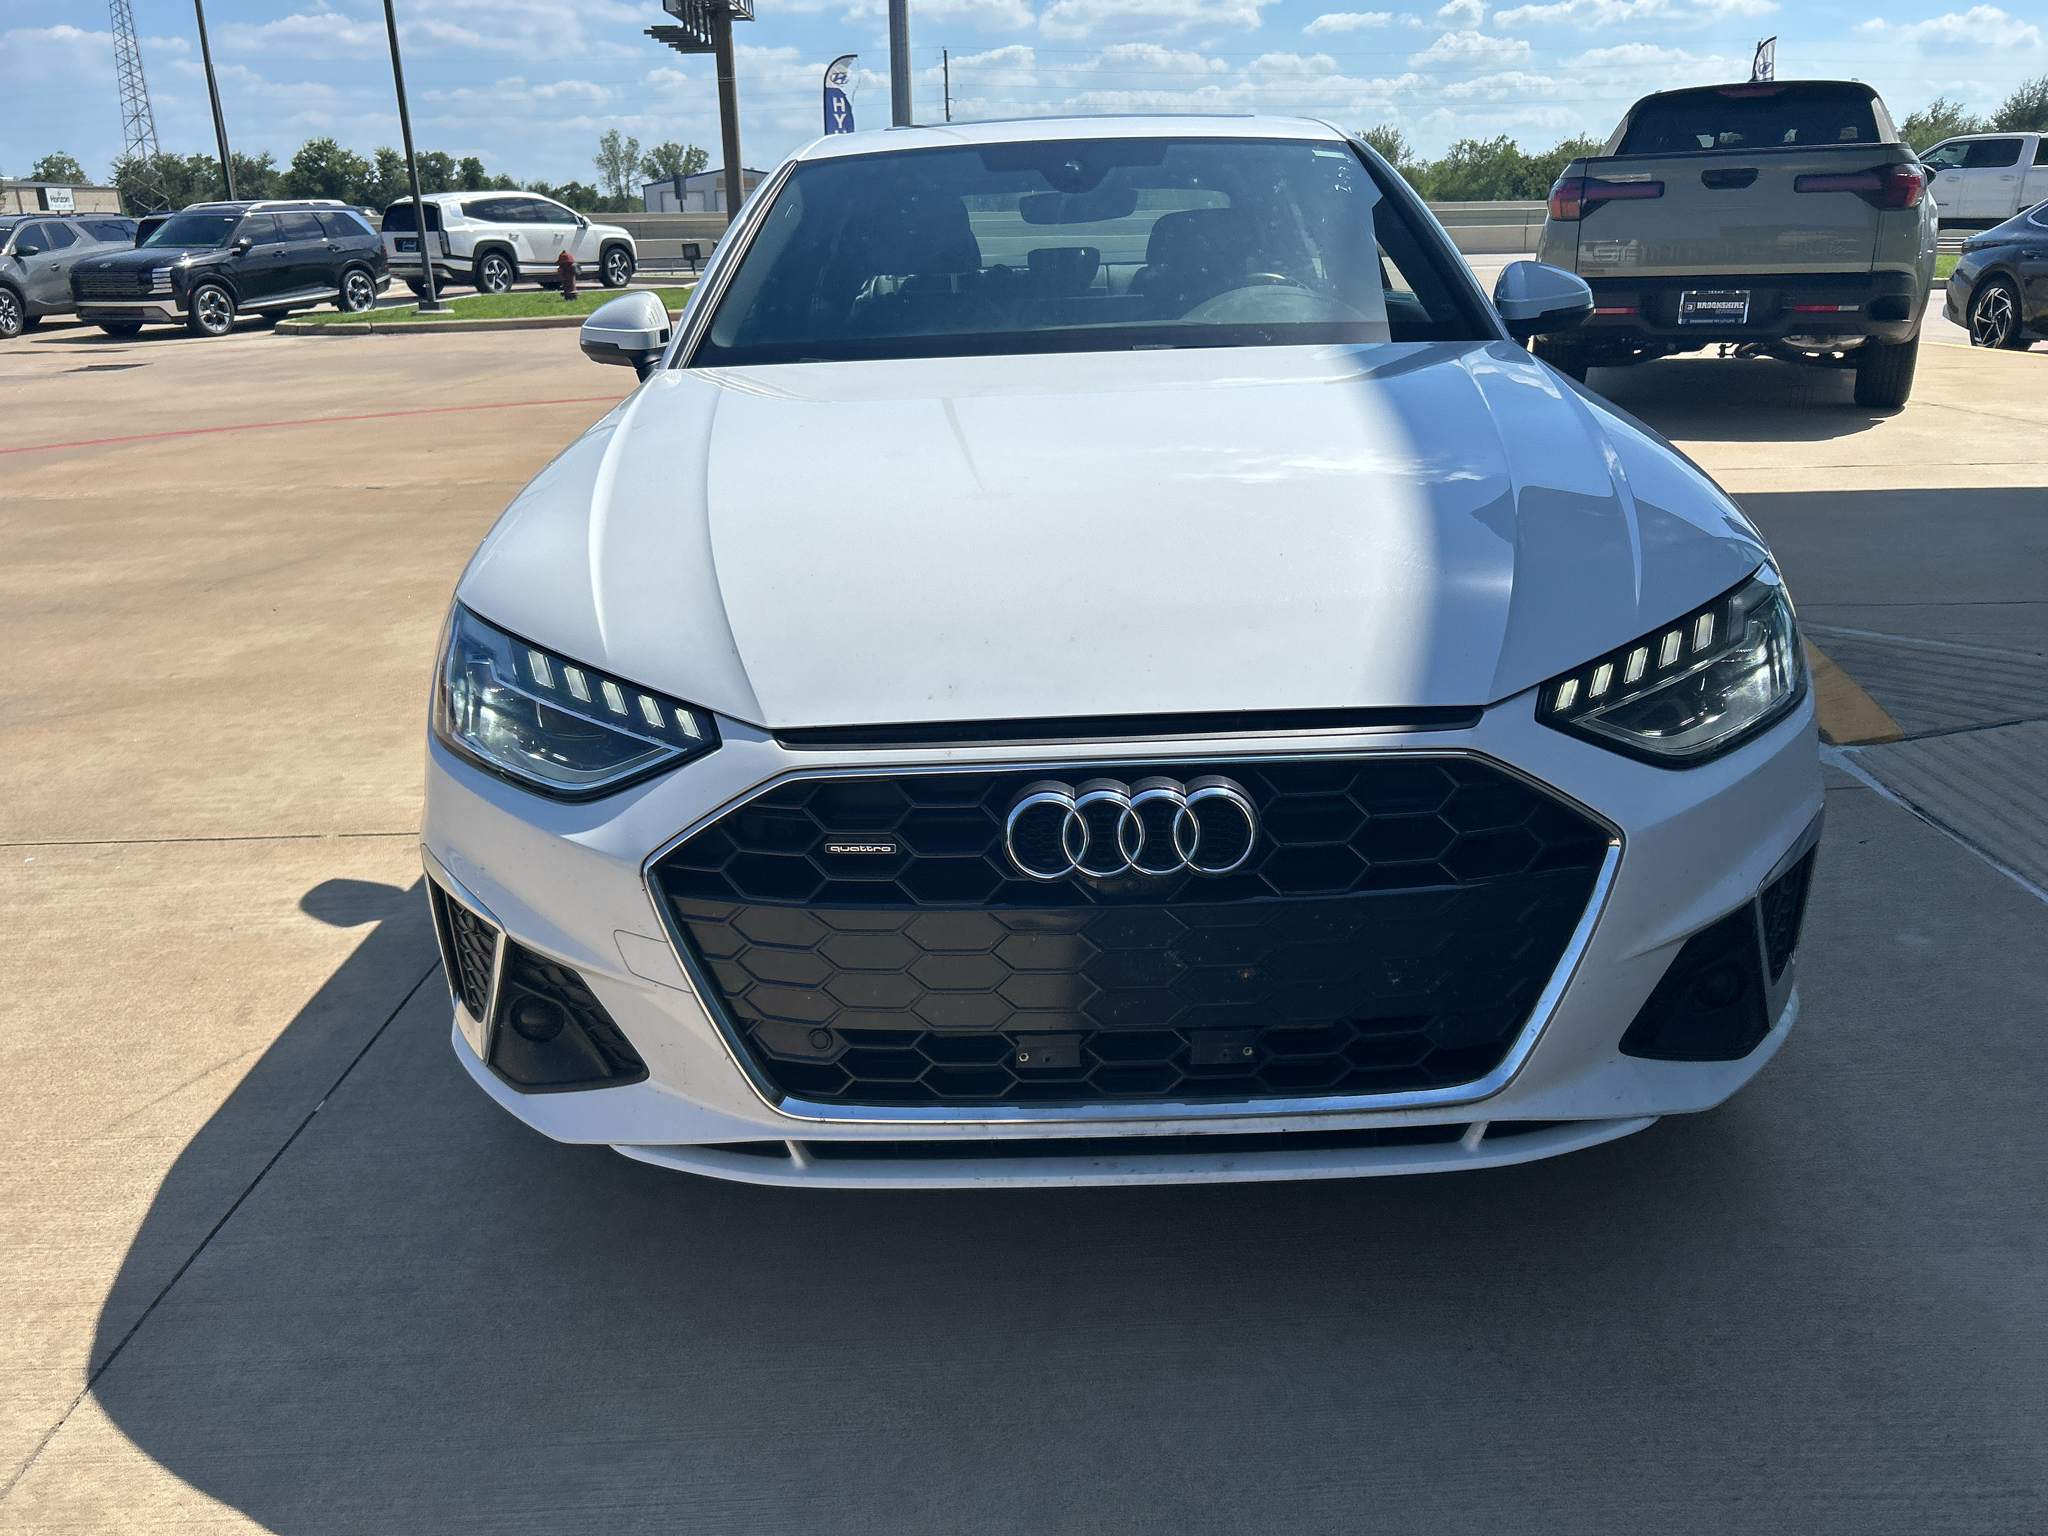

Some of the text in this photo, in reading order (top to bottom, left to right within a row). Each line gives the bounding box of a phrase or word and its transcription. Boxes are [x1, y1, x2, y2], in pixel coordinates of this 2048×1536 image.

[832, 97, 848, 134] HY
[1696, 301, 1745, 309] BROOKSHIRE
[830, 845, 891, 853] quattro
